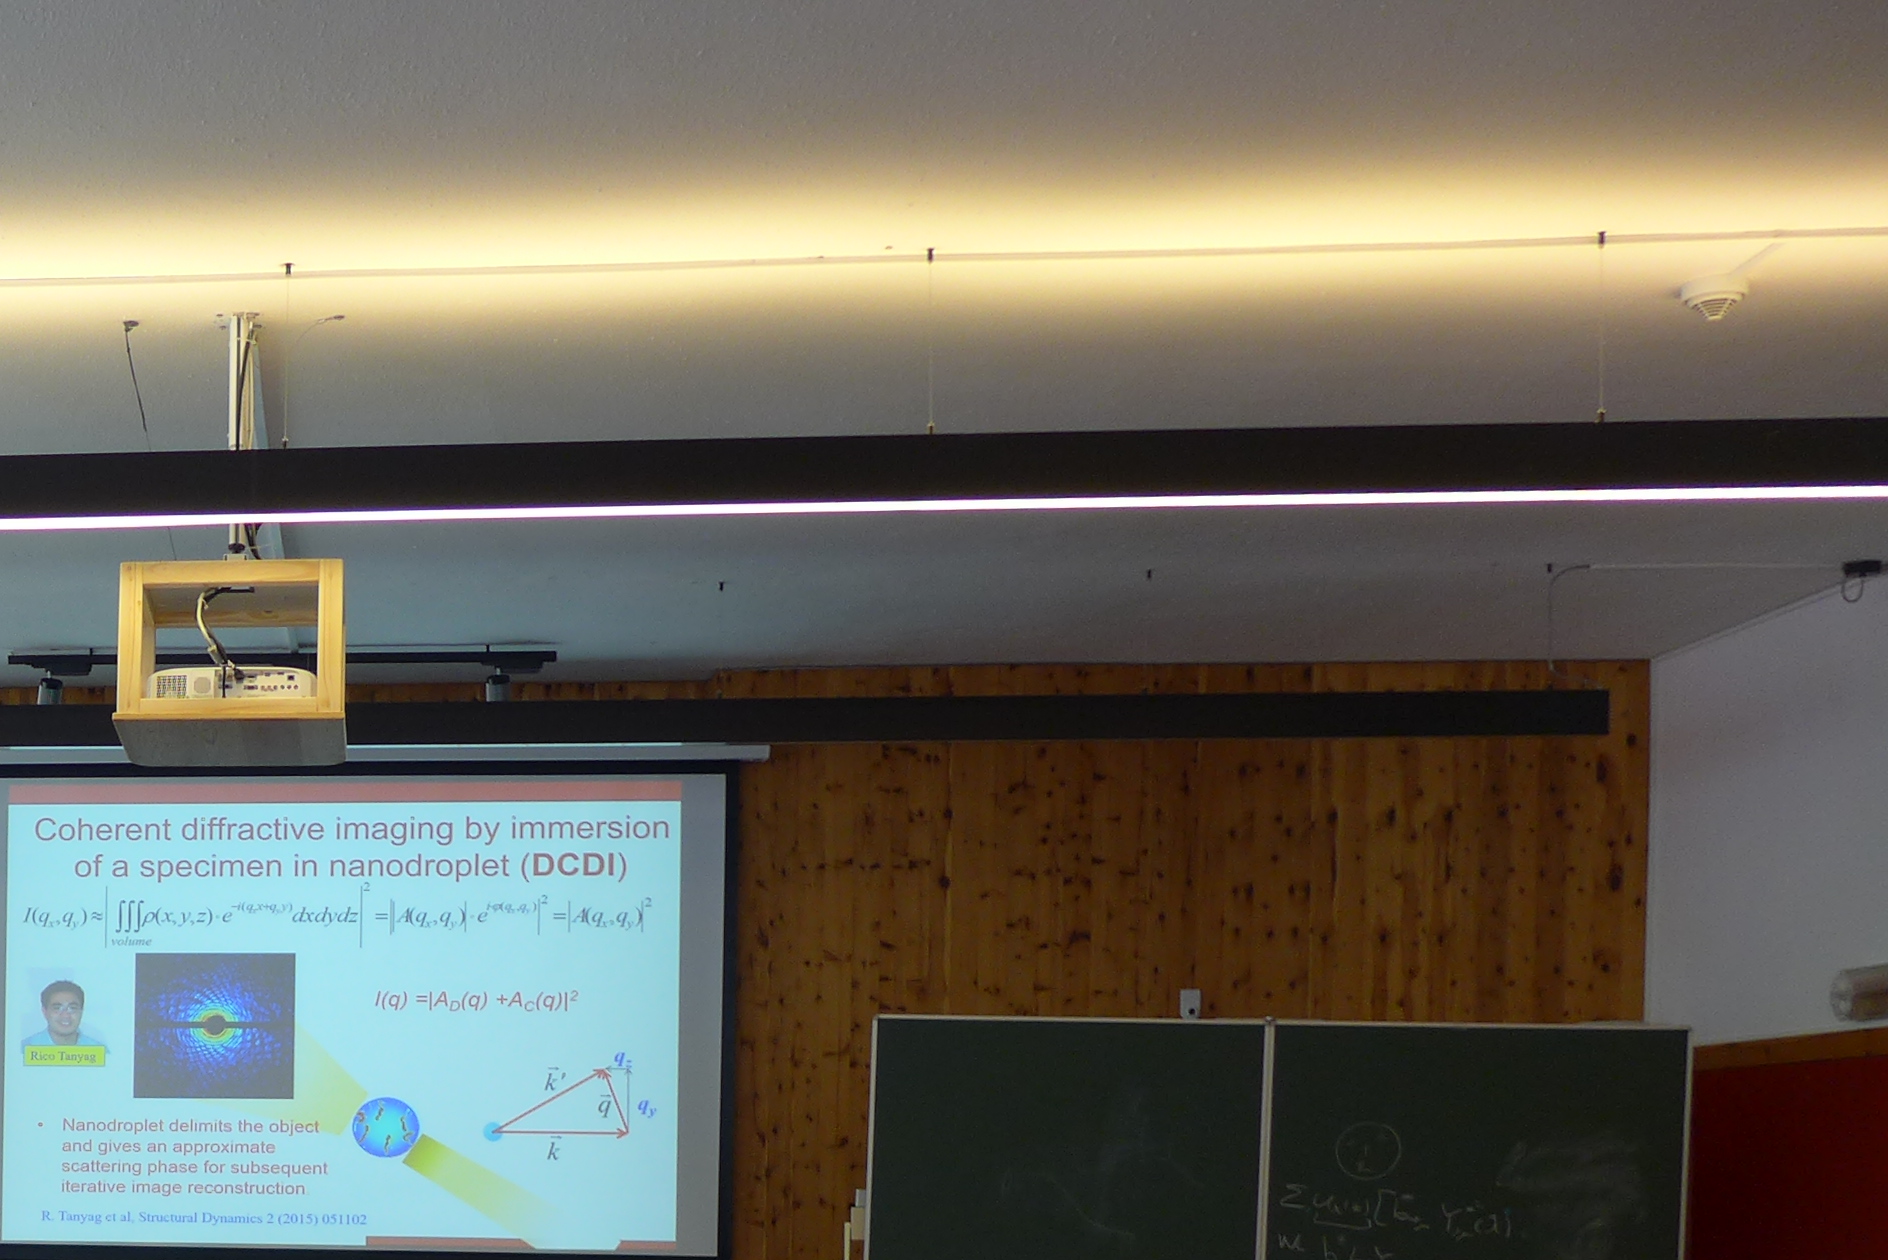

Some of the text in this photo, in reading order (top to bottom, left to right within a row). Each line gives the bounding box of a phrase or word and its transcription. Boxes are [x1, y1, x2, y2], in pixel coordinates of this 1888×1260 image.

[35, 815, 670, 846] Coherent diffractive imaging by immersion
[74, 852, 627, 883] of a specimen in nanodroplet (DCDI)
[111, 936, 153, 947] volume
[31, 1051, 96, 1064] Rico Tanyag
[62, 1118, 320, 1138] Nanodroplet delimits the object
[62, 1140, 275, 1157] and gives an approximate
[61, 1160, 329, 1179] scattering phase for subsequent
[61, 1179, 126, 1194] iterative
[131, 1180, 182, 1197] image
[41, 1210, 54, 1221] R.
[59, 1210, 102, 1224] Tanyag
[105, 1211, 116, 1222] et
[138, 1211, 198, 1223] Structural
[202, 1212, 262, 1226] Dynamics
[267, 1213, 274, 1224] 2
[278, 1213, 318, 1226] (2015)
[322, 1214, 367, 1225] 051102
